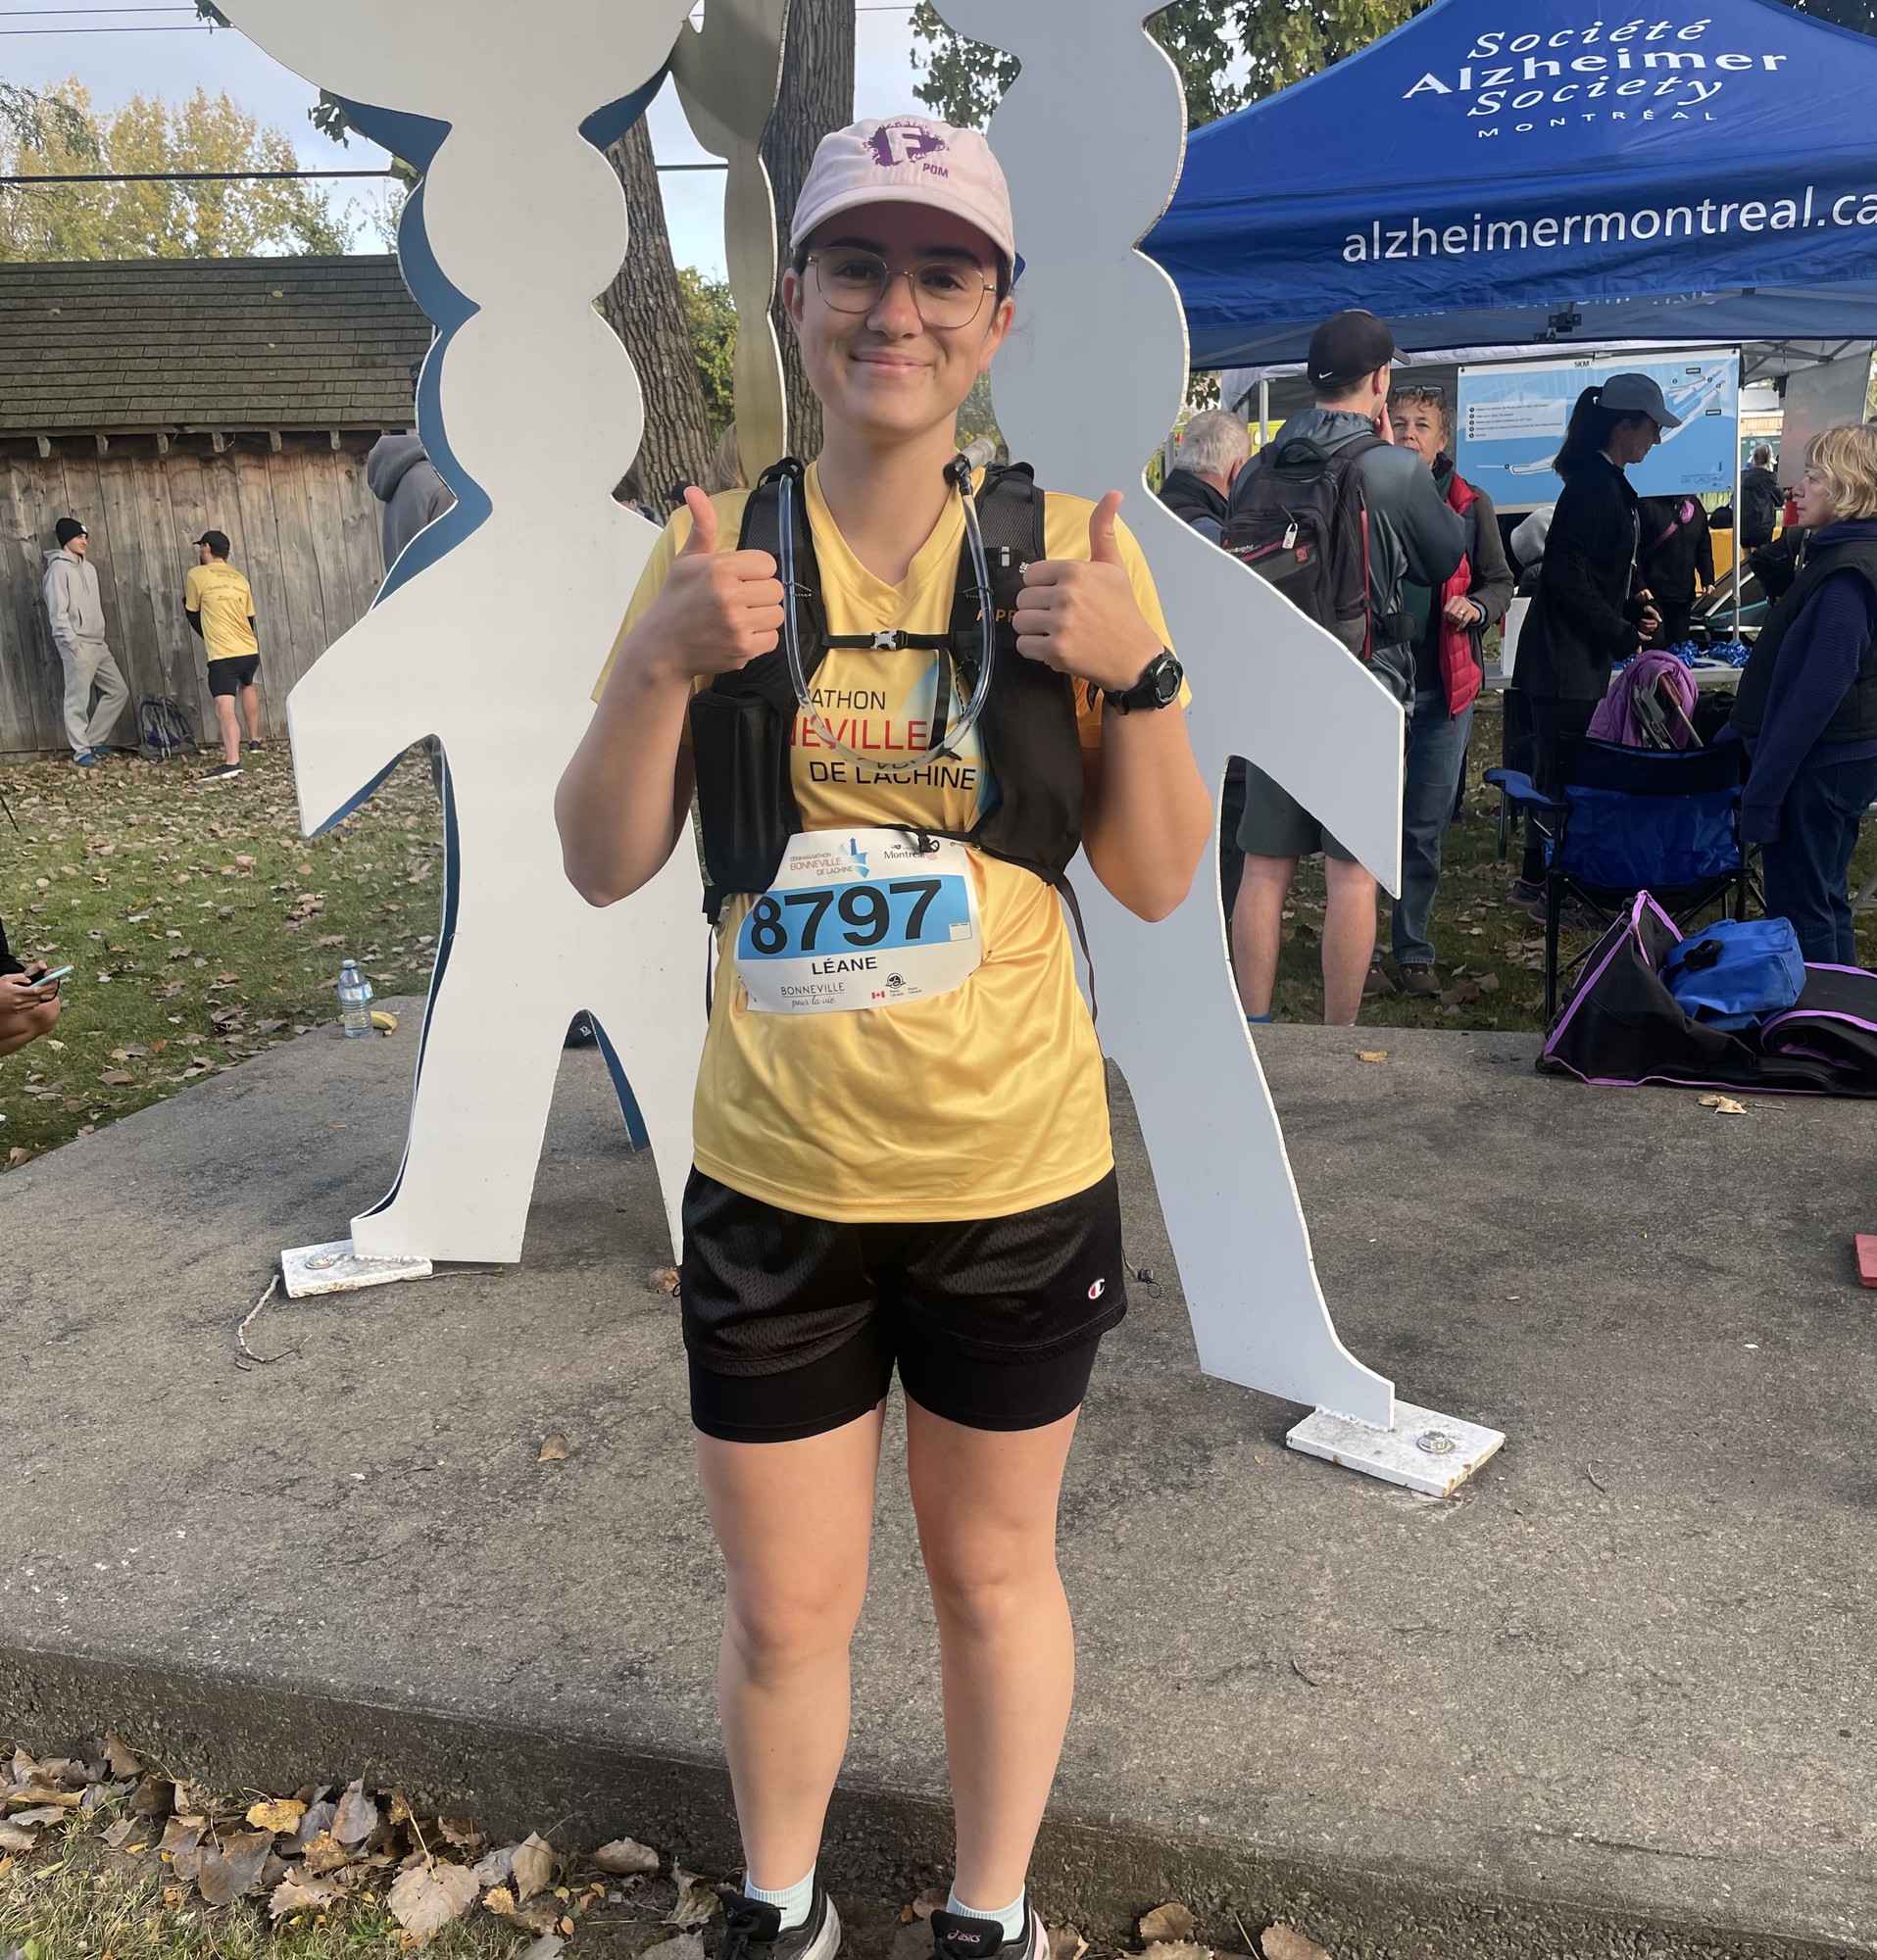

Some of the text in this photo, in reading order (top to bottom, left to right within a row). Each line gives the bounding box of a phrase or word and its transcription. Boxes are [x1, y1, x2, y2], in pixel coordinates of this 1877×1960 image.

[1467, 19, 1712, 60] Société
[1402, 47, 1788, 99] Alzheimer
[1467, 75, 1723, 118] Society
[1477, 110, 1718, 138] MONTRÉAL
[1342, 185, 1877, 263] alzheimermontreal.ca
[1574, 360, 1590, 368] 5KM
[807, 688, 886, 710] ATHON
[810, 761, 846, 783] DE
[789, 857, 842, 871] BONNEVILLE
[826, 865, 854, 875] LACHINE
[751, 879, 942, 955] 8797
[812, 956, 878, 975] LÉANE
[780, 982, 845, 996] BONNEVILLE
[792, 995, 836, 1008] pour la vie
[958, 1932, 981, 1943] asics
